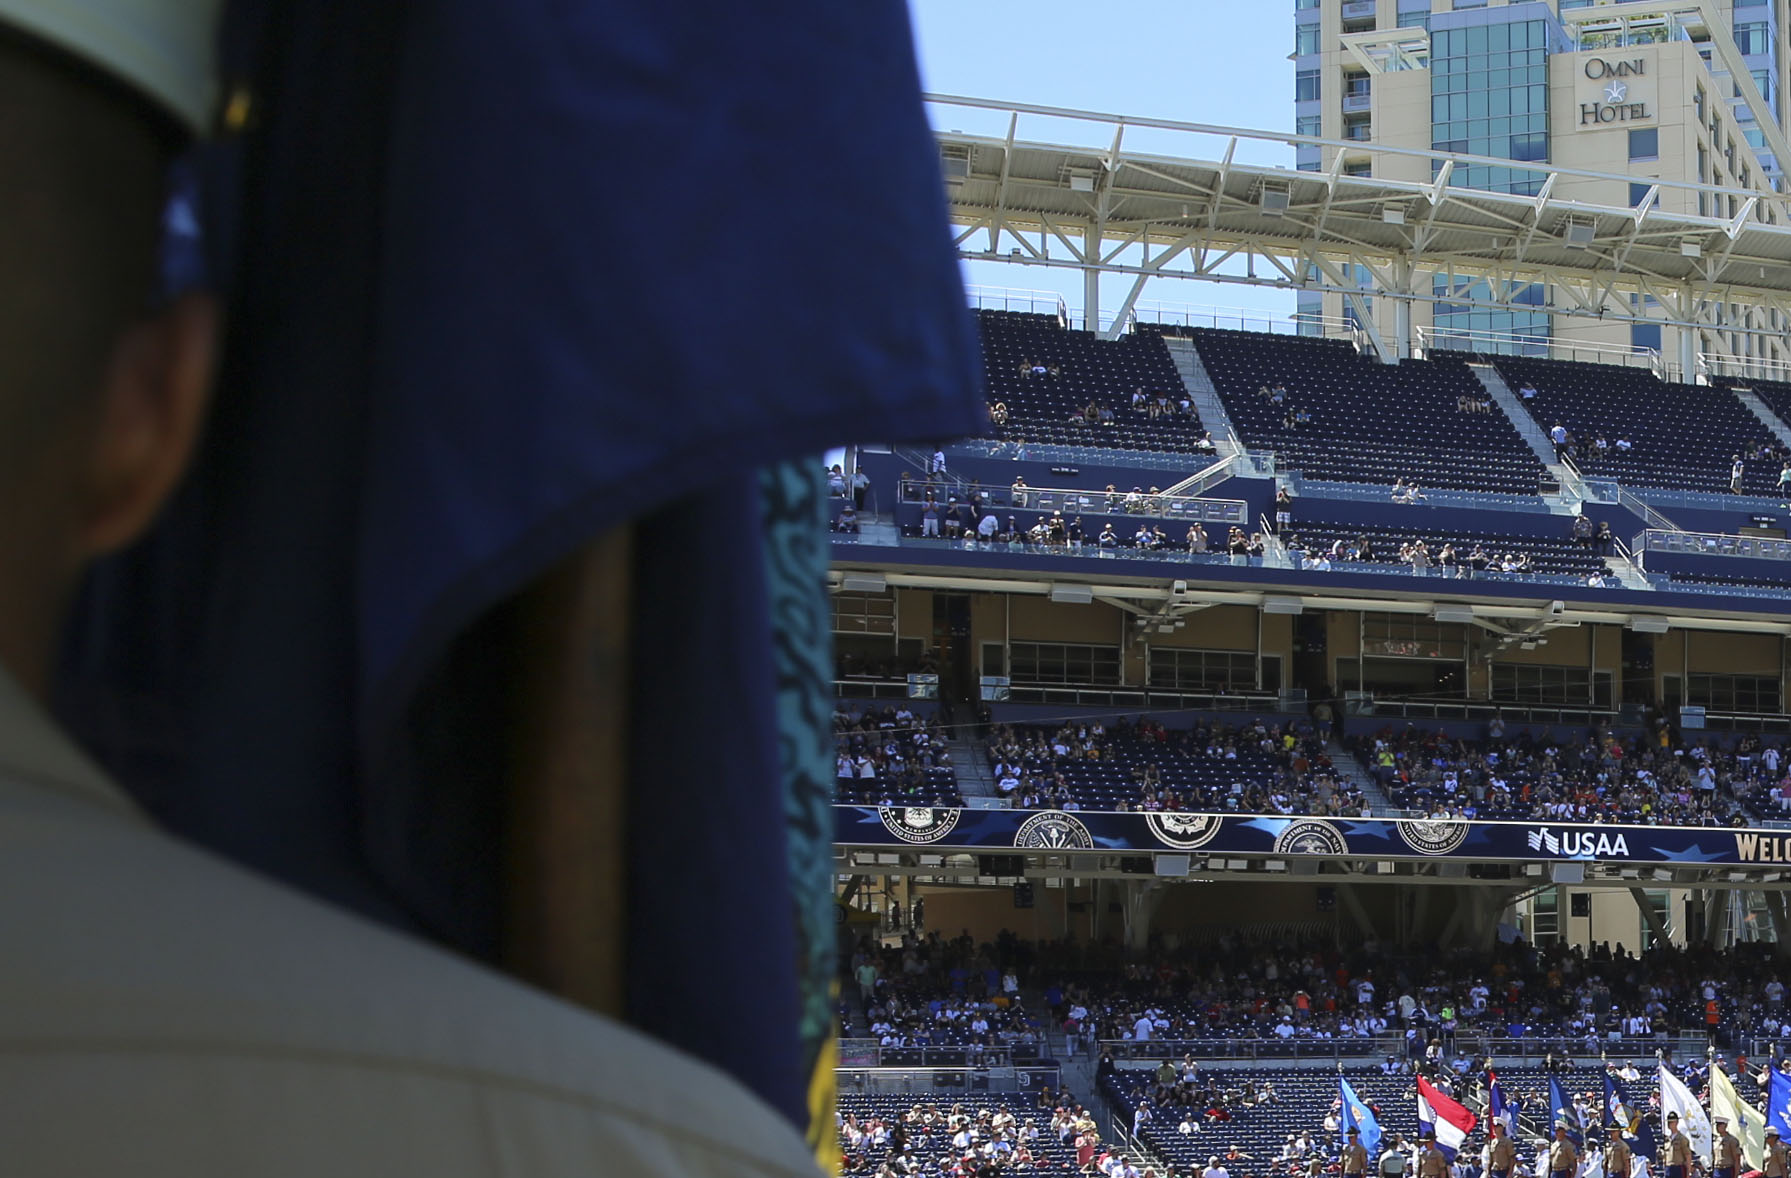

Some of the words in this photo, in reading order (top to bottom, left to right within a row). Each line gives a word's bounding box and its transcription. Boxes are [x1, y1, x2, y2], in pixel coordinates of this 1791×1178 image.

[1585, 58, 1644, 79] OMNI
[1580, 102, 1652, 124] HOTEL
[1017, 814, 1051, 845] DEPARTMENT
[1563, 831, 1629, 856] USAA
